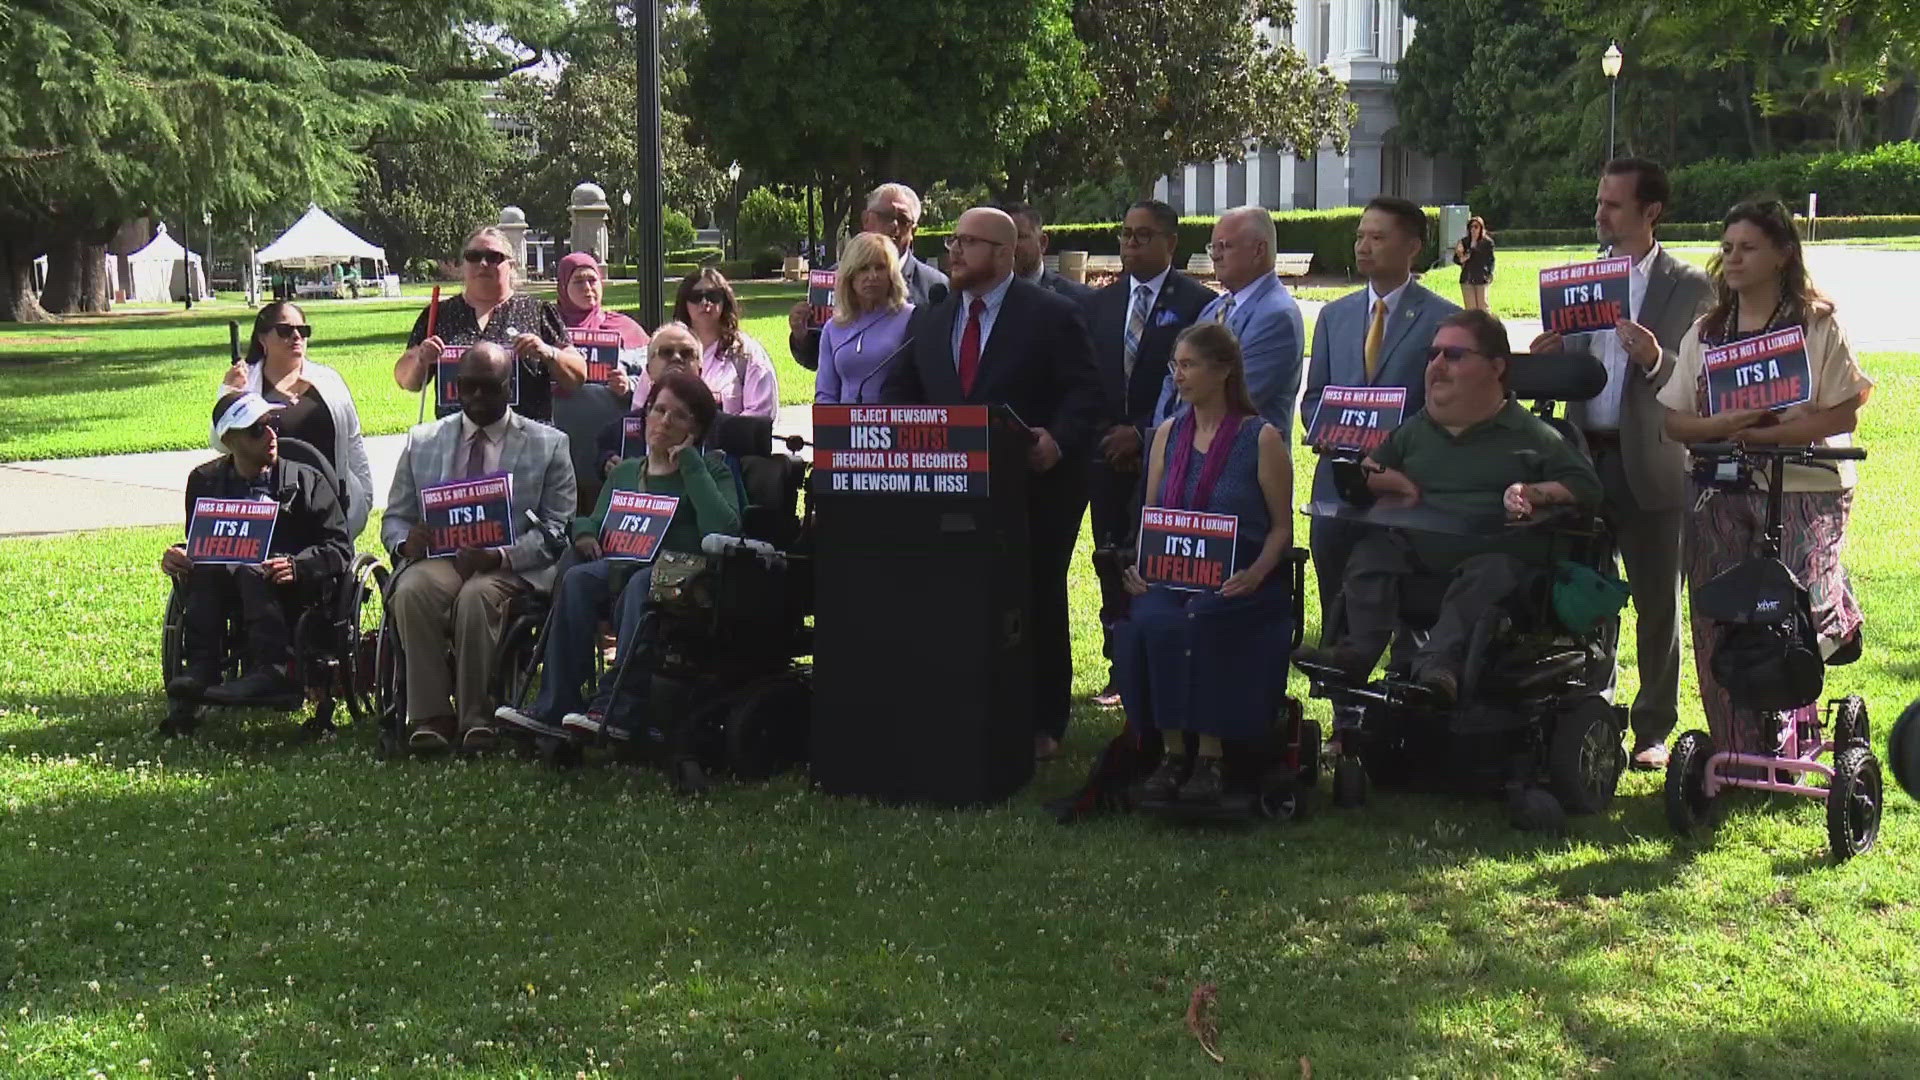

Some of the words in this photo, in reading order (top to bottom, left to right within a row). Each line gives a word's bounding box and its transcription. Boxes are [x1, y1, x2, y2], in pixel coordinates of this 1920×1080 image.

[1560, 269, 1569, 280] IS
[1570, 267, 1586, 278] NOT
[1588, 265, 1594, 276] A
[1596, 261, 1628, 274] LUXURY
[1564, 285, 1589, 306] IT'S
[1593, 283, 1603, 300] A
[1551, 301, 1621, 333] LIFELINE
[590, 347, 598, 362] A
[1729, 349, 1738, 360] IS
[1740, 343, 1756, 358] NOT
[1759, 340, 1766, 352] A
[1767, 331, 1800, 350] LUXURY
[1736, 363, 1764, 386] IT'S
[1768, 358, 1780, 379] A
[1343, 392, 1352, 401] IS
[1352, 392, 1368, 402] NOT
[1368, 392, 1376, 402] A
[1376, 392, 1402, 403] LUXURY
[1720, 376, 1800, 412] LIFELINE
[850, 409, 888, 422] REJECT
[890, 409, 948, 423] NEWSOM'S
[1340, 409, 1366, 426] IT'S
[1368, 411, 1378, 428] A
[850, 426, 892, 449] IHSS
[898, 426, 948, 450] CUTS!
[832, 452, 885, 468] ¡RECHAZA
[888, 453, 909, 468] LOS
[912, 453, 968, 468] RECORTES
[443, 491, 452, 501] IS
[452, 488, 467, 499] NOT
[469, 487, 474, 496] A
[476, 483, 504, 496] LUXURY
[832, 473, 848, 490] DE
[852, 473, 910, 492] NEWSOM
[914, 474, 931, 492] AL
[934, 475, 968, 492] IHSS!
[216, 504, 224, 512] IS
[225, 504, 240, 513] NOT
[240, 504, 246, 514] A
[248, 505, 276, 514] LUXURY
[628, 496, 635, 506] IS
[634, 497, 646, 508] NOT
[646, 499, 652, 508] A
[652, 500, 676, 512] LUXURY
[448, 506, 472, 525] IT'S
[476, 505, 485, 522] A
[618, 514, 642, 532] IT'S
[639, 517, 651, 533] A
[1144, 512, 1163, 524] IHSS
[1164, 514, 1173, 526] IS
[1174, 516, 1190, 528] NOT
[1192, 517, 1198, 528] A
[1202, 518, 1234, 532] LUXURY
[213, 520, 238, 536] IT'S
[239, 521, 250, 536] A
[434, 521, 504, 548] LIFELINE
[194, 537, 261, 558] LIFELINE
[602, 530, 656, 556] LIFELINE
[1165, 536, 1192, 556] IT'S
[1195, 539, 1206, 558] A
[1146, 555, 1222, 586] LIFELINE
